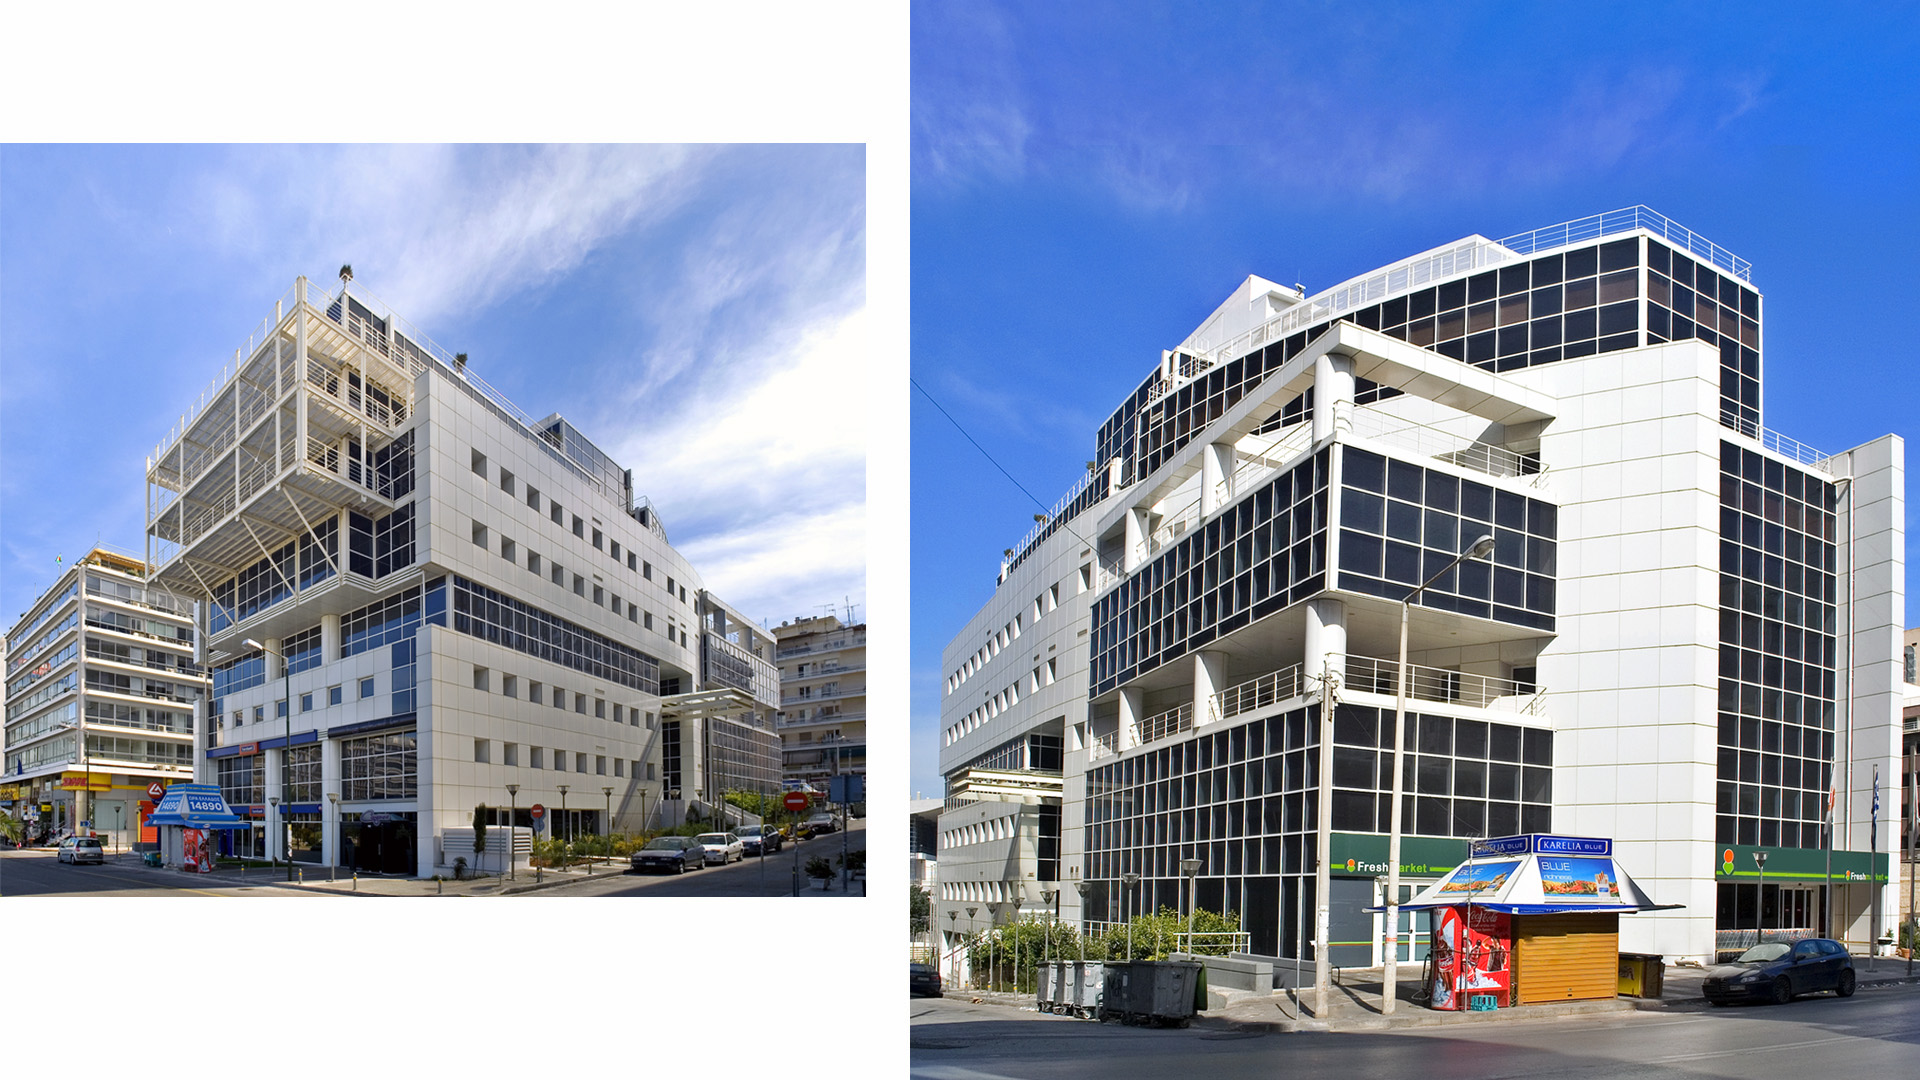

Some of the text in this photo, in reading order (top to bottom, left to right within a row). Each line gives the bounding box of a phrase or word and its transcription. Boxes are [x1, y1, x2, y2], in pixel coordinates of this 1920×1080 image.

[62, 778, 87, 787] DHL
[190, 801, 222, 811] 14890
[1543, 840, 1582, 851] KARELIA
[1357, 861, 1427, 873] Fresharket
[1541, 861, 1571, 872] BLUE
